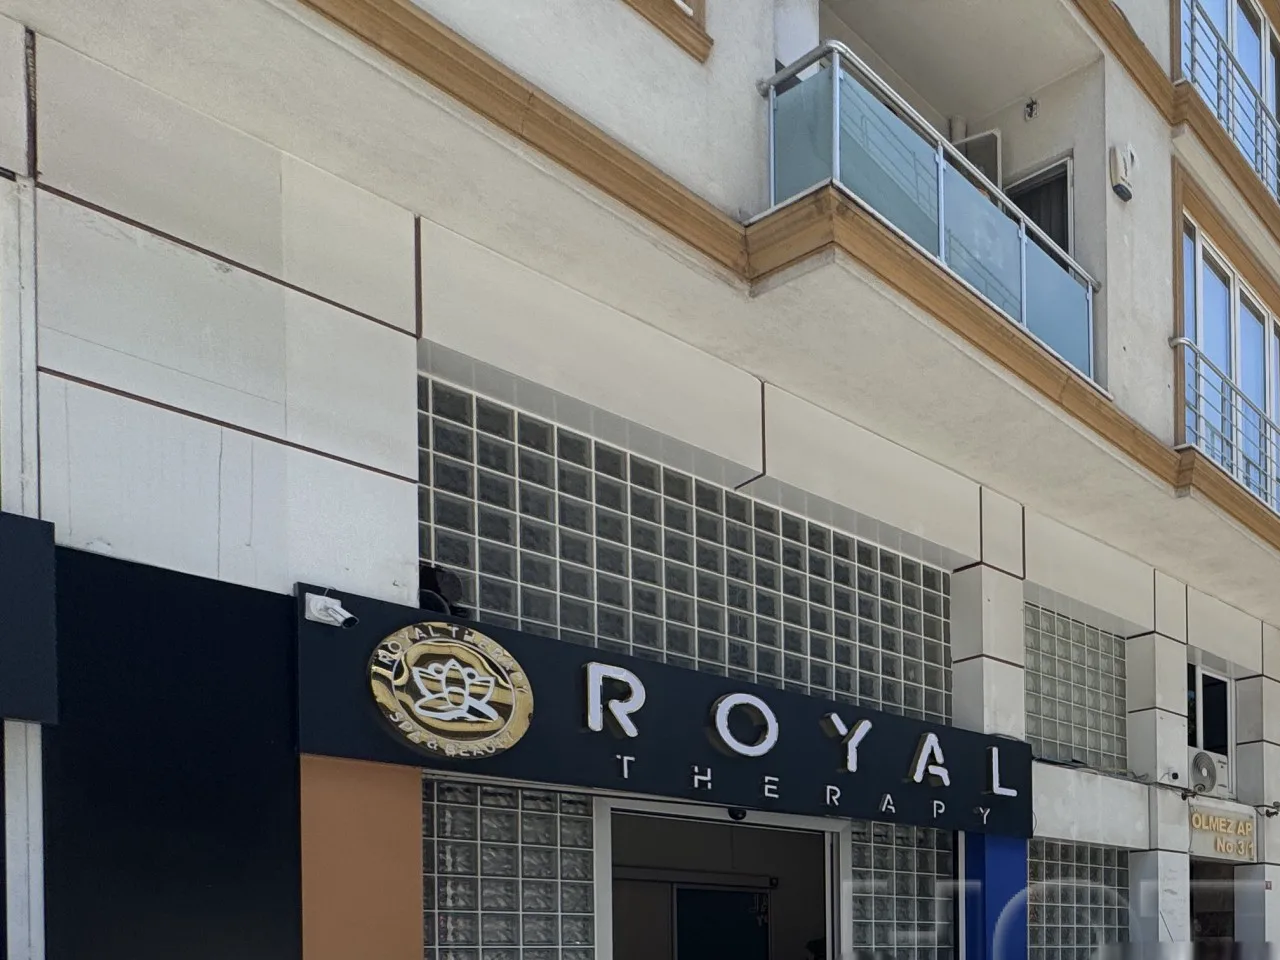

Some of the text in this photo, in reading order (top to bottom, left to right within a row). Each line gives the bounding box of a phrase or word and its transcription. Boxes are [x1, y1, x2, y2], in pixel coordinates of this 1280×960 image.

[377, 626, 441, 666] ROYAL
[389, 711, 421, 744] SPA
[585, 661, 1017, 797] ROYAL
[616, 755, 991, 825] THERAPY
[1236, 821, 1253, 836] AP
